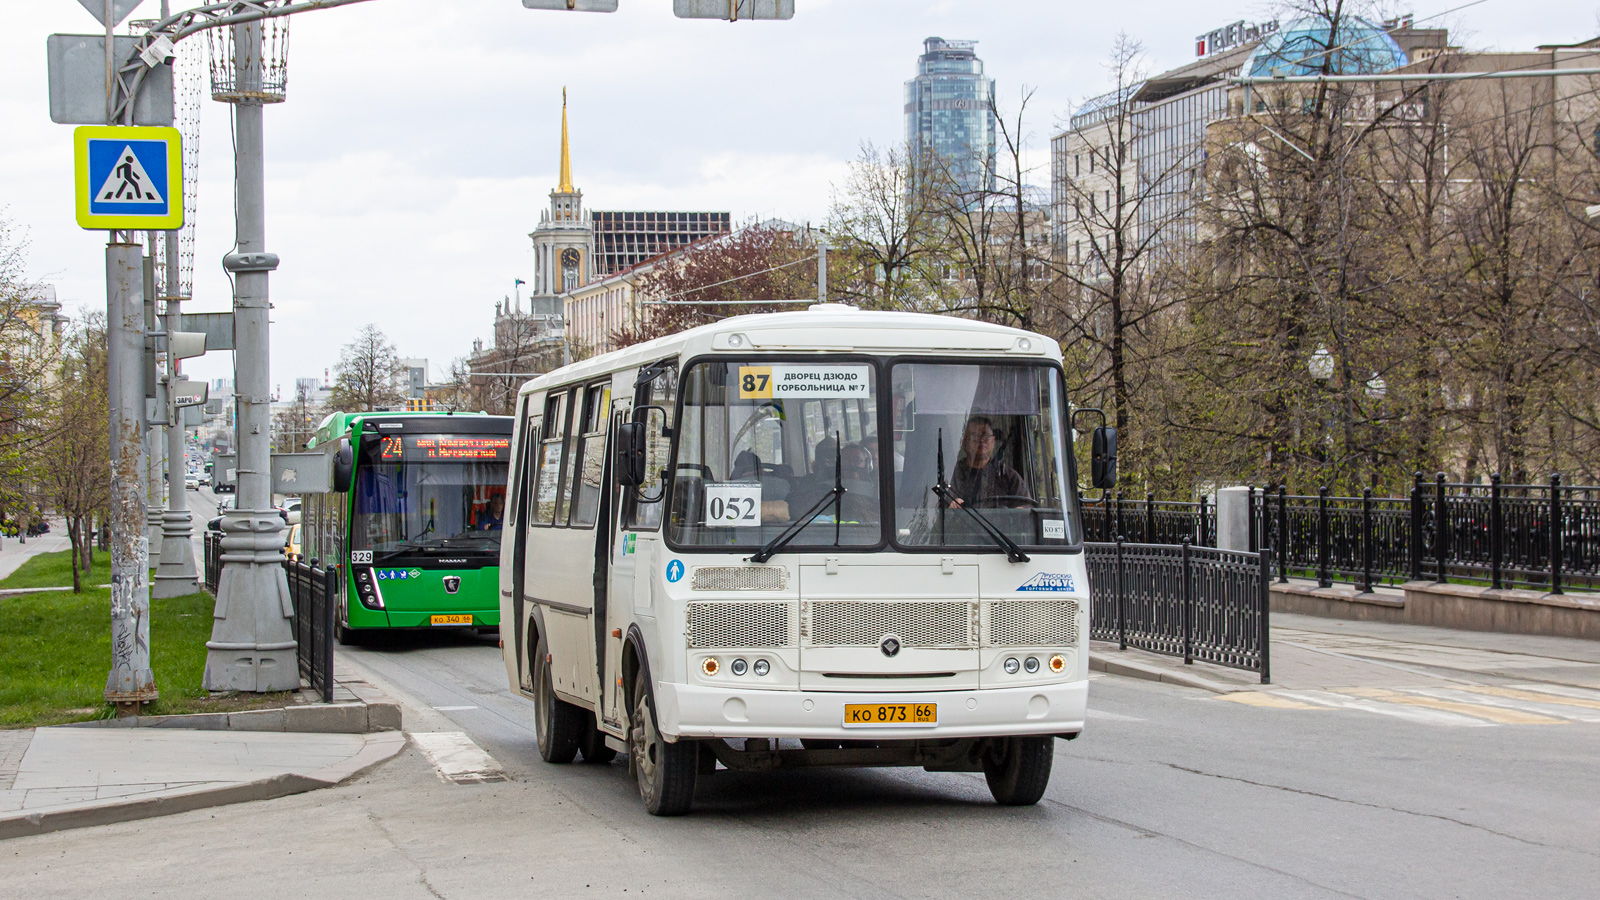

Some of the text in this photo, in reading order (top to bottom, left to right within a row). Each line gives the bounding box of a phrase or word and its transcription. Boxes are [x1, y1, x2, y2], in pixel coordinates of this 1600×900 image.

[1205, 20, 1245, 53] TENET
[742, 374, 770, 392] 87
[783, 373, 858, 381] ДВОРЕЦ ДЗЮДО
[777, 384, 845, 392] ГОРБОЛЬНИЦА
[382, 436, 402, 458] 24
[710, 497, 756, 520] 052
[352, 552, 372, 562] 329
[446, 615, 460, 623] 340
[852, 706, 931, 721] КО 873 66
